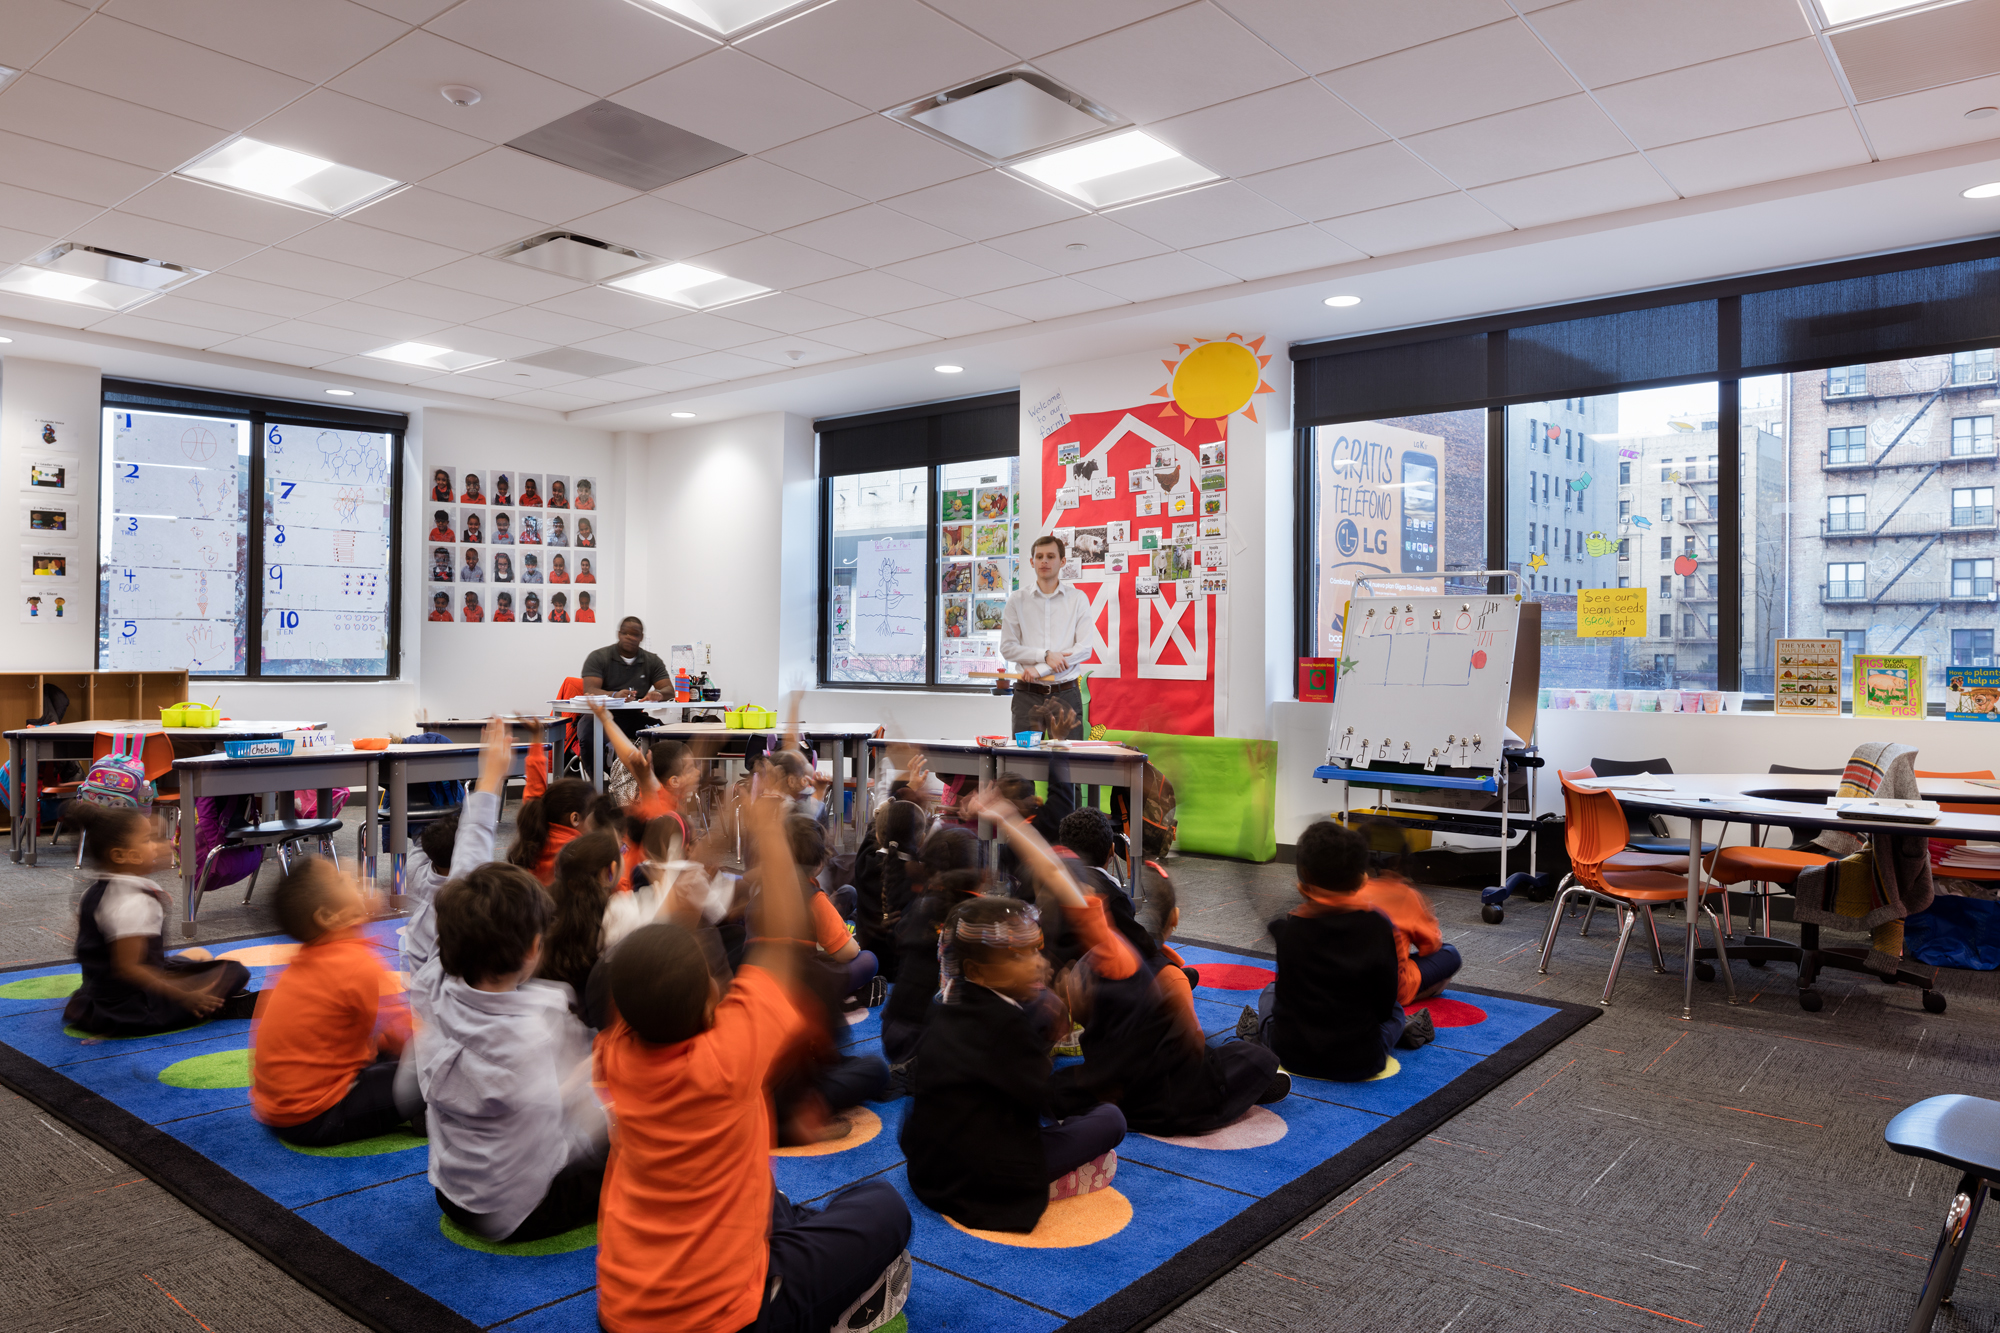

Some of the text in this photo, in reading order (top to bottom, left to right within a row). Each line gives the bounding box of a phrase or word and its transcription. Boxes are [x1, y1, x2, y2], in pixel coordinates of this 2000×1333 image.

[1028, 392, 1061, 418] Welcome
[1037, 403, 1062, 424] to our
[126, 413, 132, 428] 1
[1040, 413, 1066, 439] farm!
[268, 425, 282, 445] 6
[1331, 435, 1393, 484] GRATIS
[124, 464, 140, 479] 2
[281, 482, 297, 499] 7
[1333, 484, 1391, 521] TELÉFONO
[127, 517, 139, 532] 3
[274, 524, 286, 544] 8
[1363, 527, 1387, 555] LG
[124, 569, 136, 583] 4
[269, 564, 283, 590] 9
[119, 583, 140, 592] FOUR
[1584, 590, 1610, 603] See
[1582, 602, 1644, 615] bean seeds
[280, 611, 299, 629] 10
[1362, 616, 1369, 634] i
[1384, 615, 1395, 630] a
[1404, 616, 1415, 626] e
[1432, 621, 1441, 631] u
[1584, 615, 1636, 626] GROW into
[121, 620, 137, 638] 5
[1595, 627, 1627, 637] crops!
[117, 636, 137, 645] FIVE
[1328, 633, 1343, 643] boo
[1860, 658, 1883, 668] PIGS
[1967, 676, 1988, 686] help
[1892, 706, 1917, 717] PIGS
[1340, 734, 1351, 751] n
[1356, 746, 1366, 763] d
[1379, 745, 1386, 759] b
[1402, 752, 1408, 762] y
[1427, 757, 1433, 768] k
